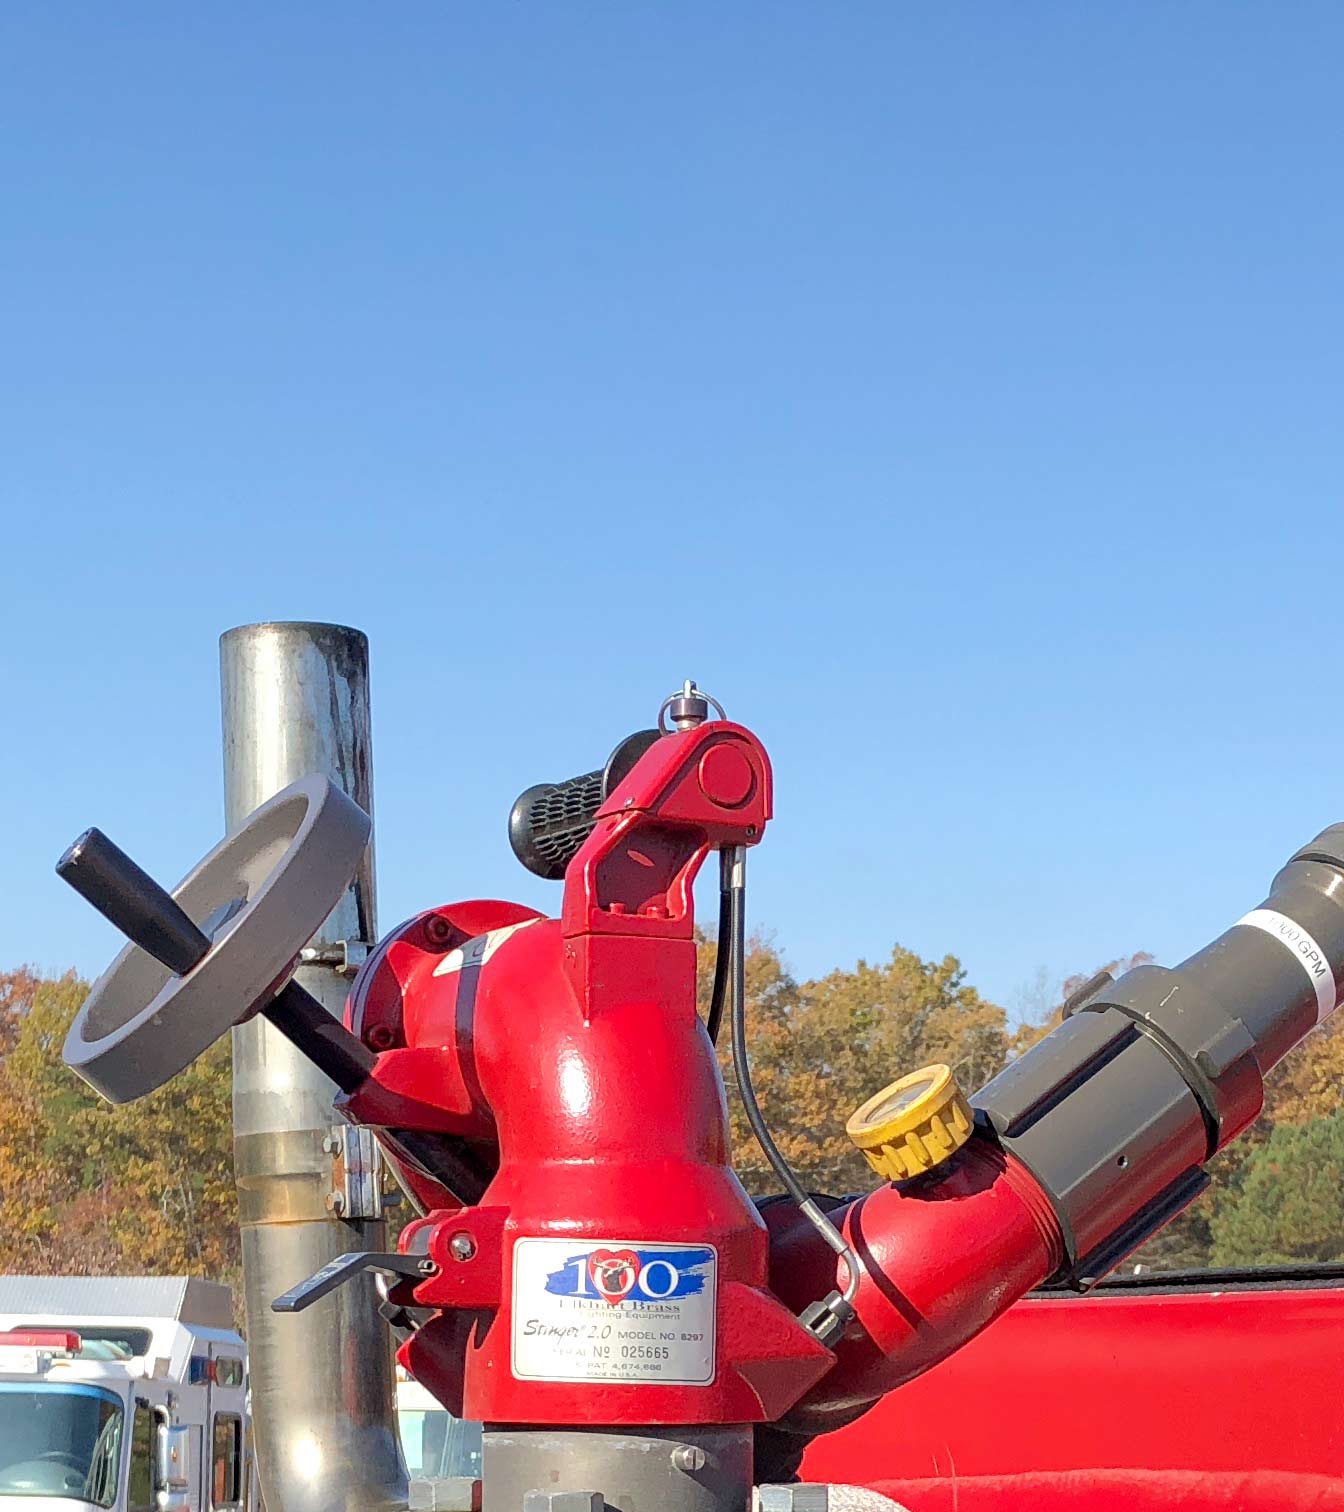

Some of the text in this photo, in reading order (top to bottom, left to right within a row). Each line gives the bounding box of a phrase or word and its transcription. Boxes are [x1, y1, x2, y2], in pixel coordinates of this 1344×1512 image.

[1297, 940, 1327, 979] GPM
[567, 1258, 679, 1298] 100
[633, 1301, 680, 1311] Brass
[626, 1311, 680, 1320] Equipment
[587, 1325, 612, 1339] 2.0
[618, 1331, 656, 1340] MODEL
[681, 1333, 704, 1342] 8297
[552, 1348, 586, 1356] ERIAL
[621, 1345, 669, 1359] 025665
